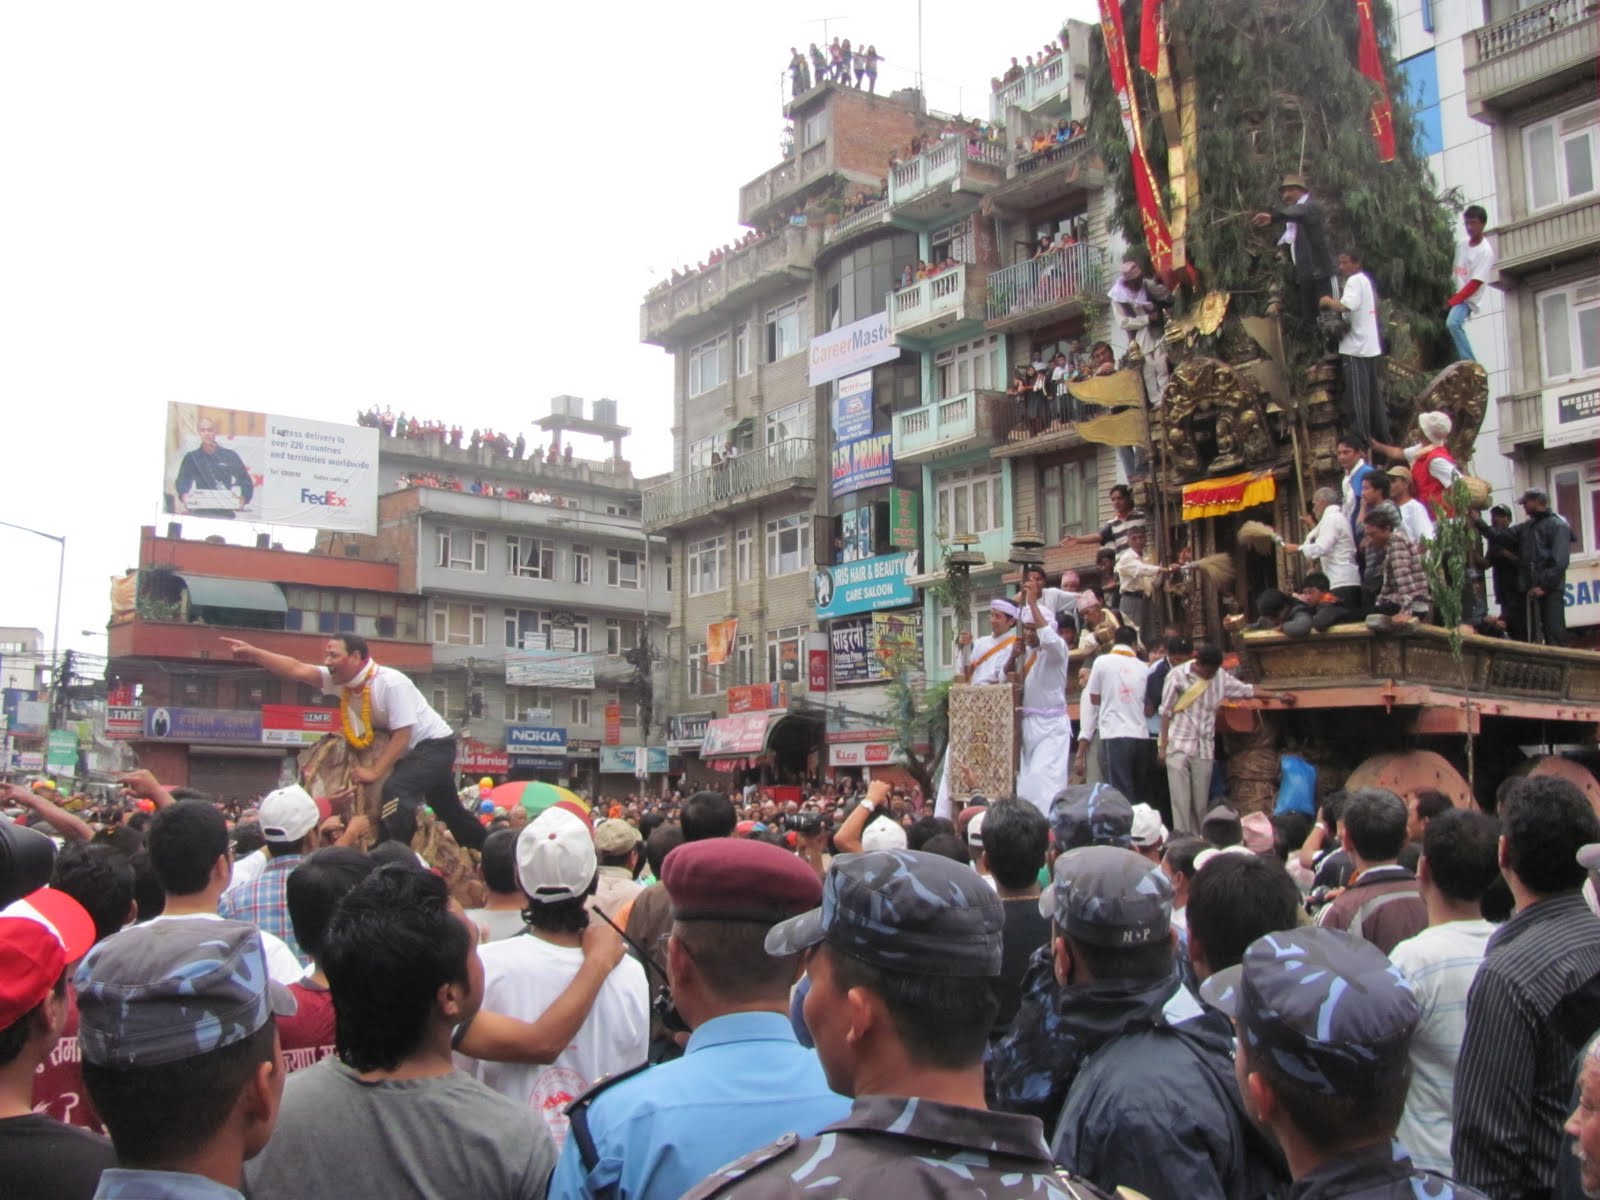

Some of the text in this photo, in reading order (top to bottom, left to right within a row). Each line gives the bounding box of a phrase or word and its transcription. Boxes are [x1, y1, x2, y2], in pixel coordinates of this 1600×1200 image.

[305, 431, 336, 444] delivery
[337, 436, 345, 444] to
[290, 440, 304, 450] 220
[305, 443, 342, 455] countries
[270, 451, 370, 470] and territories worldwide
[832, 435, 891, 480] FLEX PRINT
[300, 487, 347, 508] FedEx
[835, 558, 905, 587] IRIS HAIR & BEAUTY
[845, 583, 893, 602] CARE SALOON
[812, 676, 825, 686] LG
[512, 729, 562, 742] NOKIA
[477, 755, 508, 766] Service
